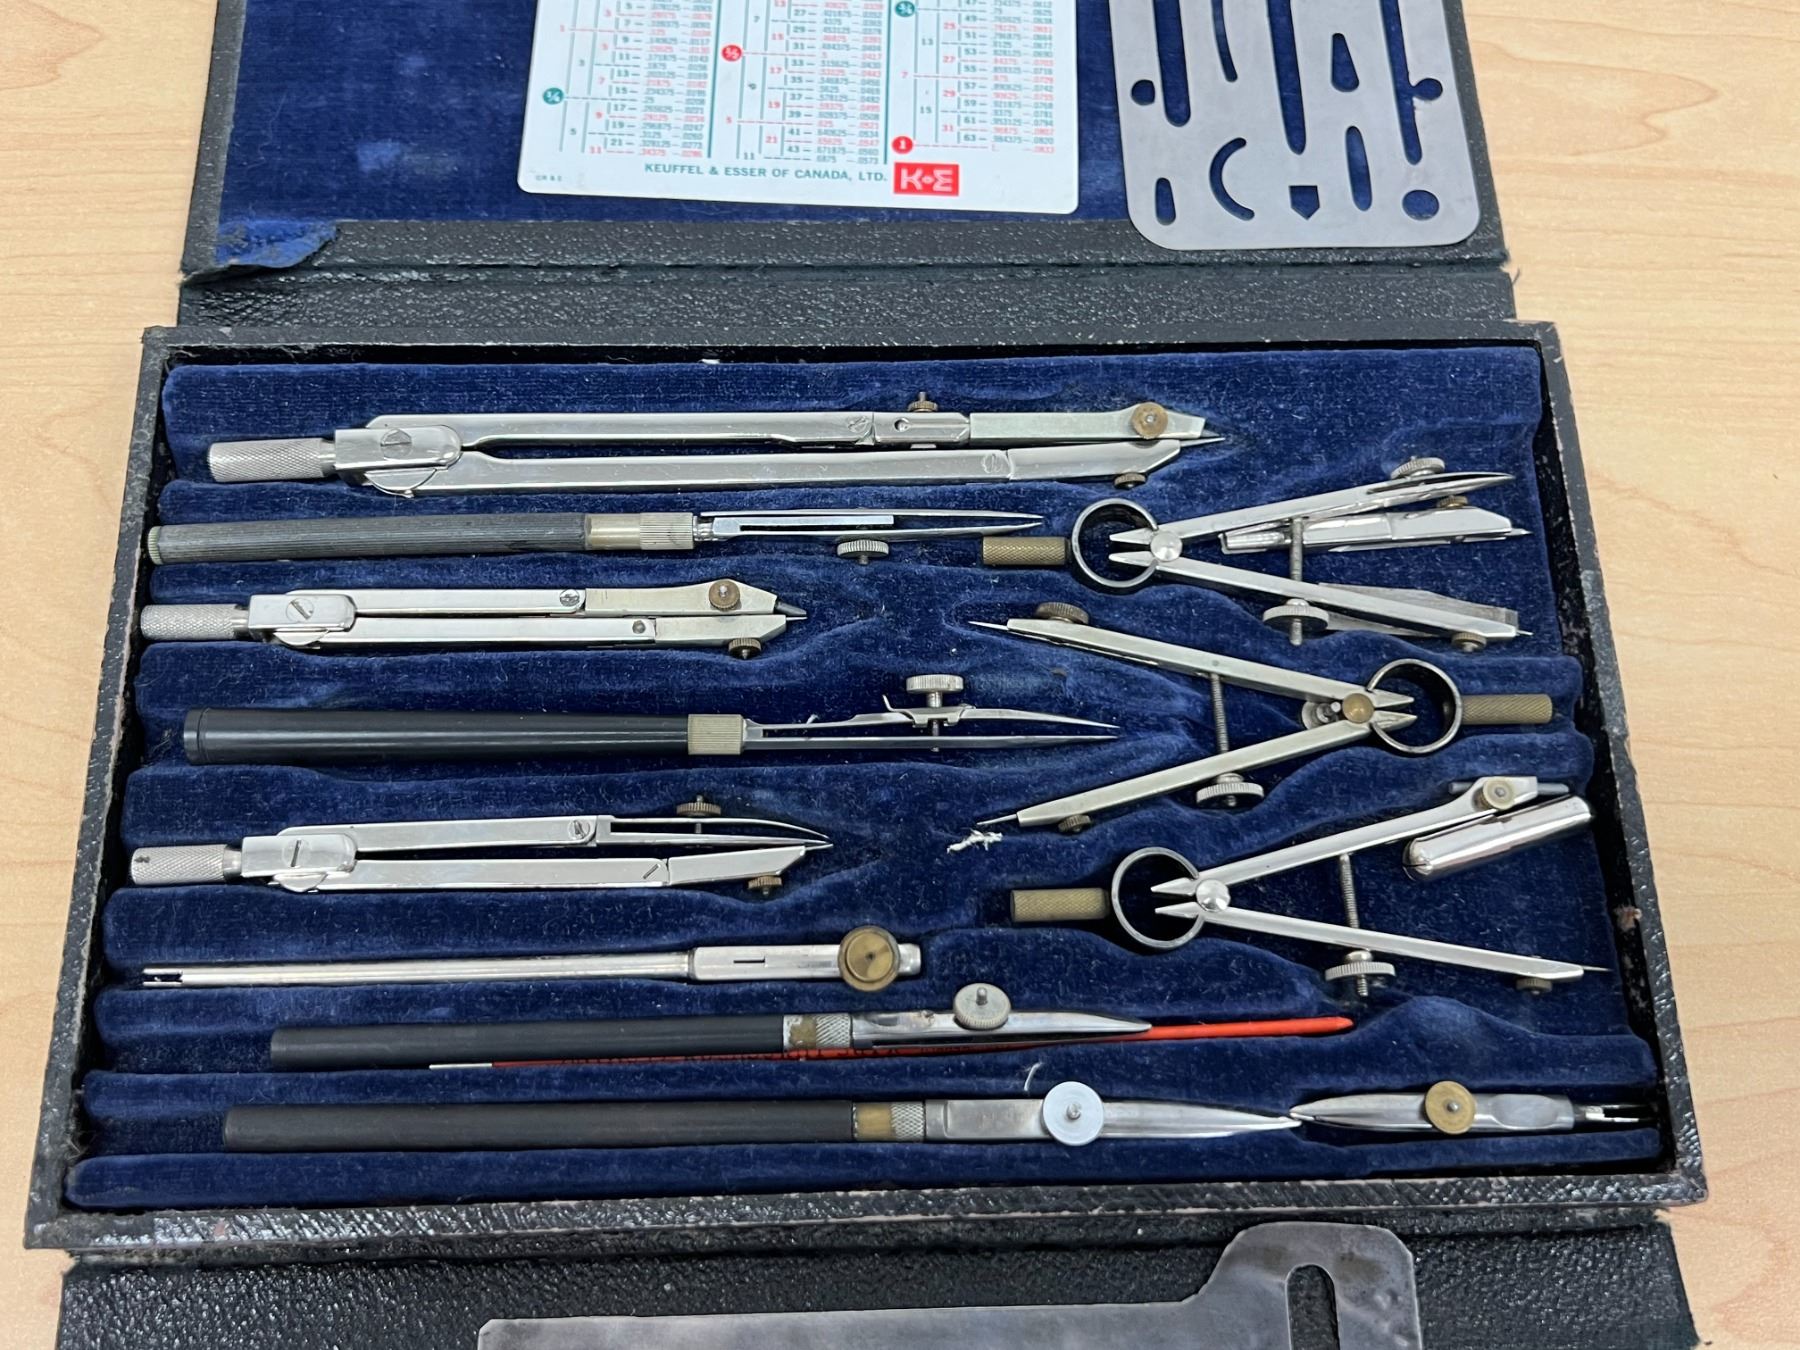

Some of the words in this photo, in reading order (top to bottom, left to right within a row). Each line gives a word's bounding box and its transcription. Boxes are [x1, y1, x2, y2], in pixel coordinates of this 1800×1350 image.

[920, 106, 932, 114] 15
[612, 121, 625, 129] 19
[788, 128, 800, 136] 41
[610, 138, 623, 146] 21
[899, 139, 907, 150] 1
[590, 146, 602, 154] 11
[645, 163, 704, 175] KEUFFEL
[709, 166, 718, 175] &
[725, 167, 767, 177] ESSER
[772, 168, 790, 178] OF
[795, 169, 853, 181] CANADA,
[859, 171, 888, 181] LTD.
